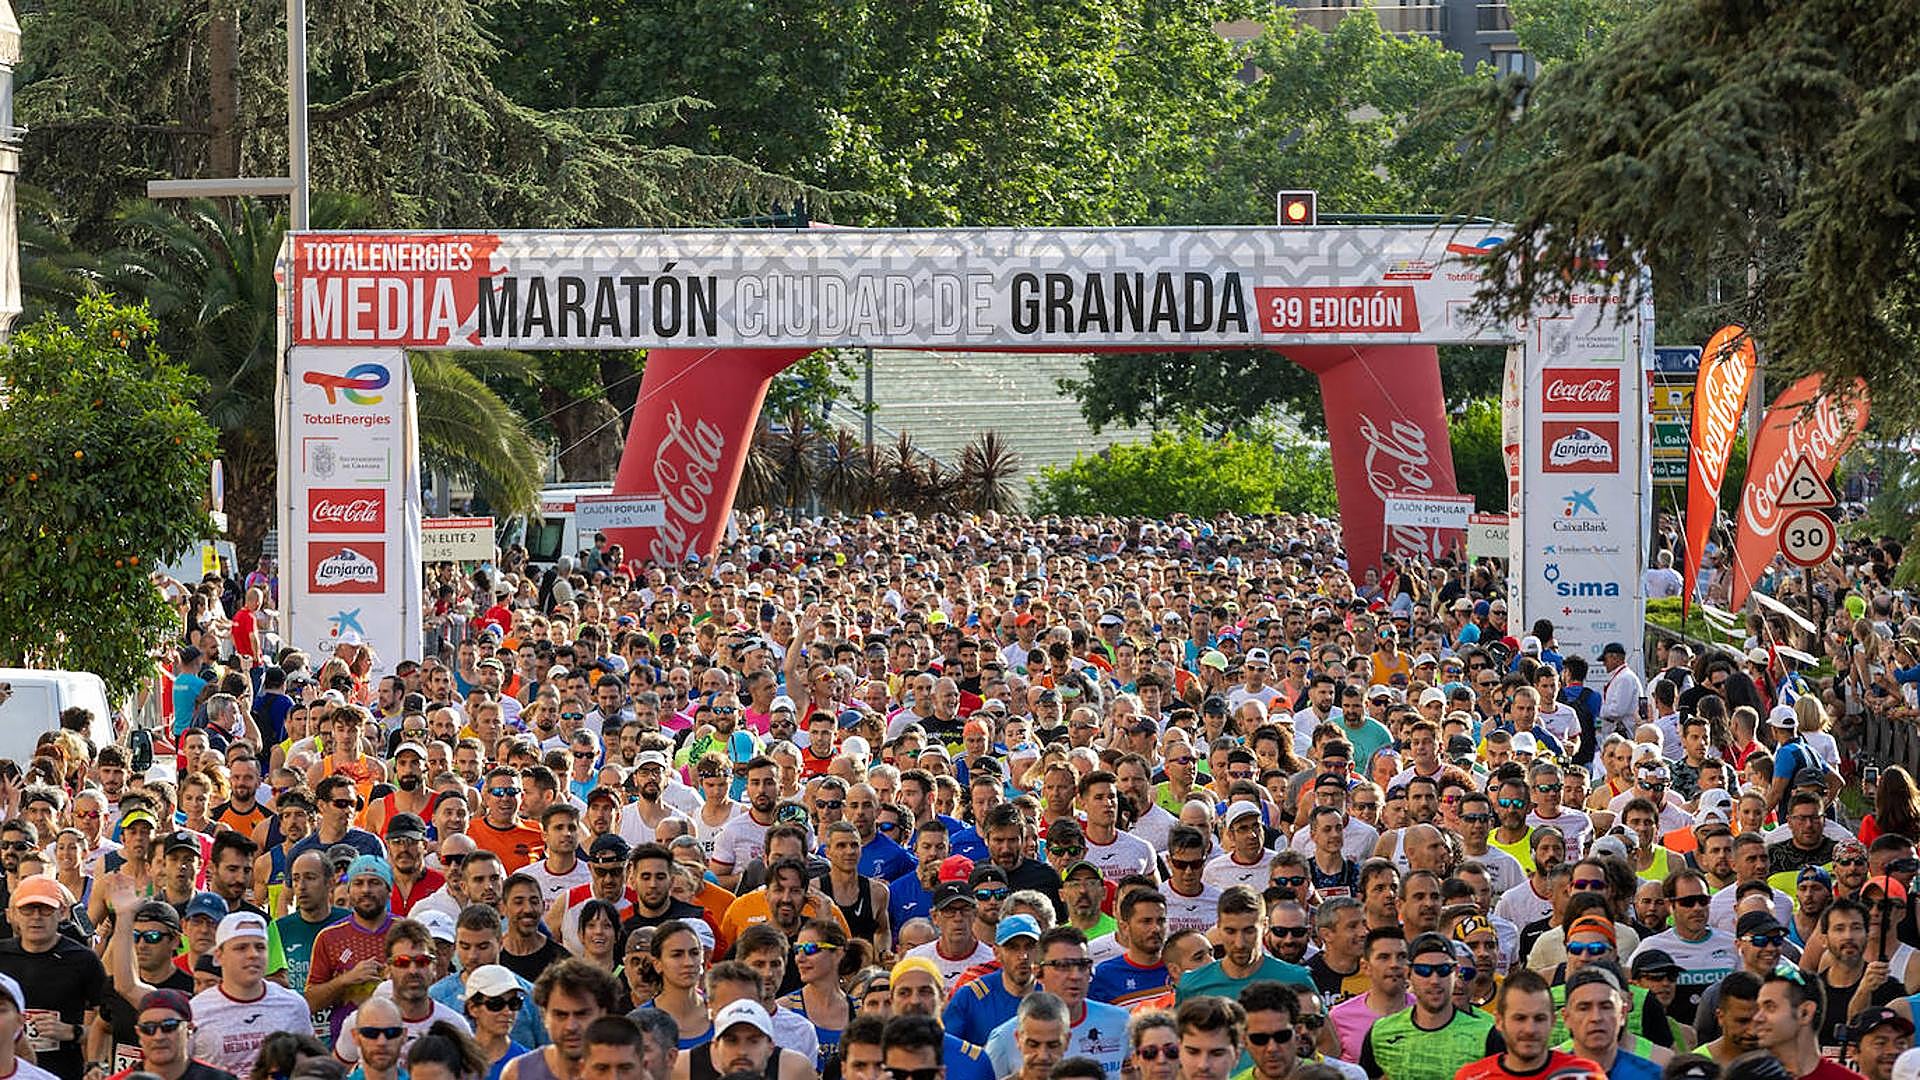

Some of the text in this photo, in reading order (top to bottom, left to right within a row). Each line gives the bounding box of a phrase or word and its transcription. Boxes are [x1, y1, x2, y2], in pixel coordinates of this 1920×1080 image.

[303, 242, 473, 272] TOTALENERGIES
[301, 261, 1248, 340] MEDIA MARATÓN CIUDAD DE GRANADA
[1271, 290, 1403, 328] 39 EDICIÓN
[303, 413, 391, 427] TotalEnergies
[1554, 442, 1608, 457] Lanjarón
[614, 503, 656, 514] POPULAR
[1424, 504, 1466, 514] POPULAR
[1553, 520, 1608, 532] CaixaBank
[440, 532, 466, 543] ELITE
[470, 531, 477, 543] 2
[1791, 528, 1824, 548] 30
[320, 562, 375, 577] Lanjarón
[1557, 582, 1619, 596] sima
[287, 958, 309, 973] San
